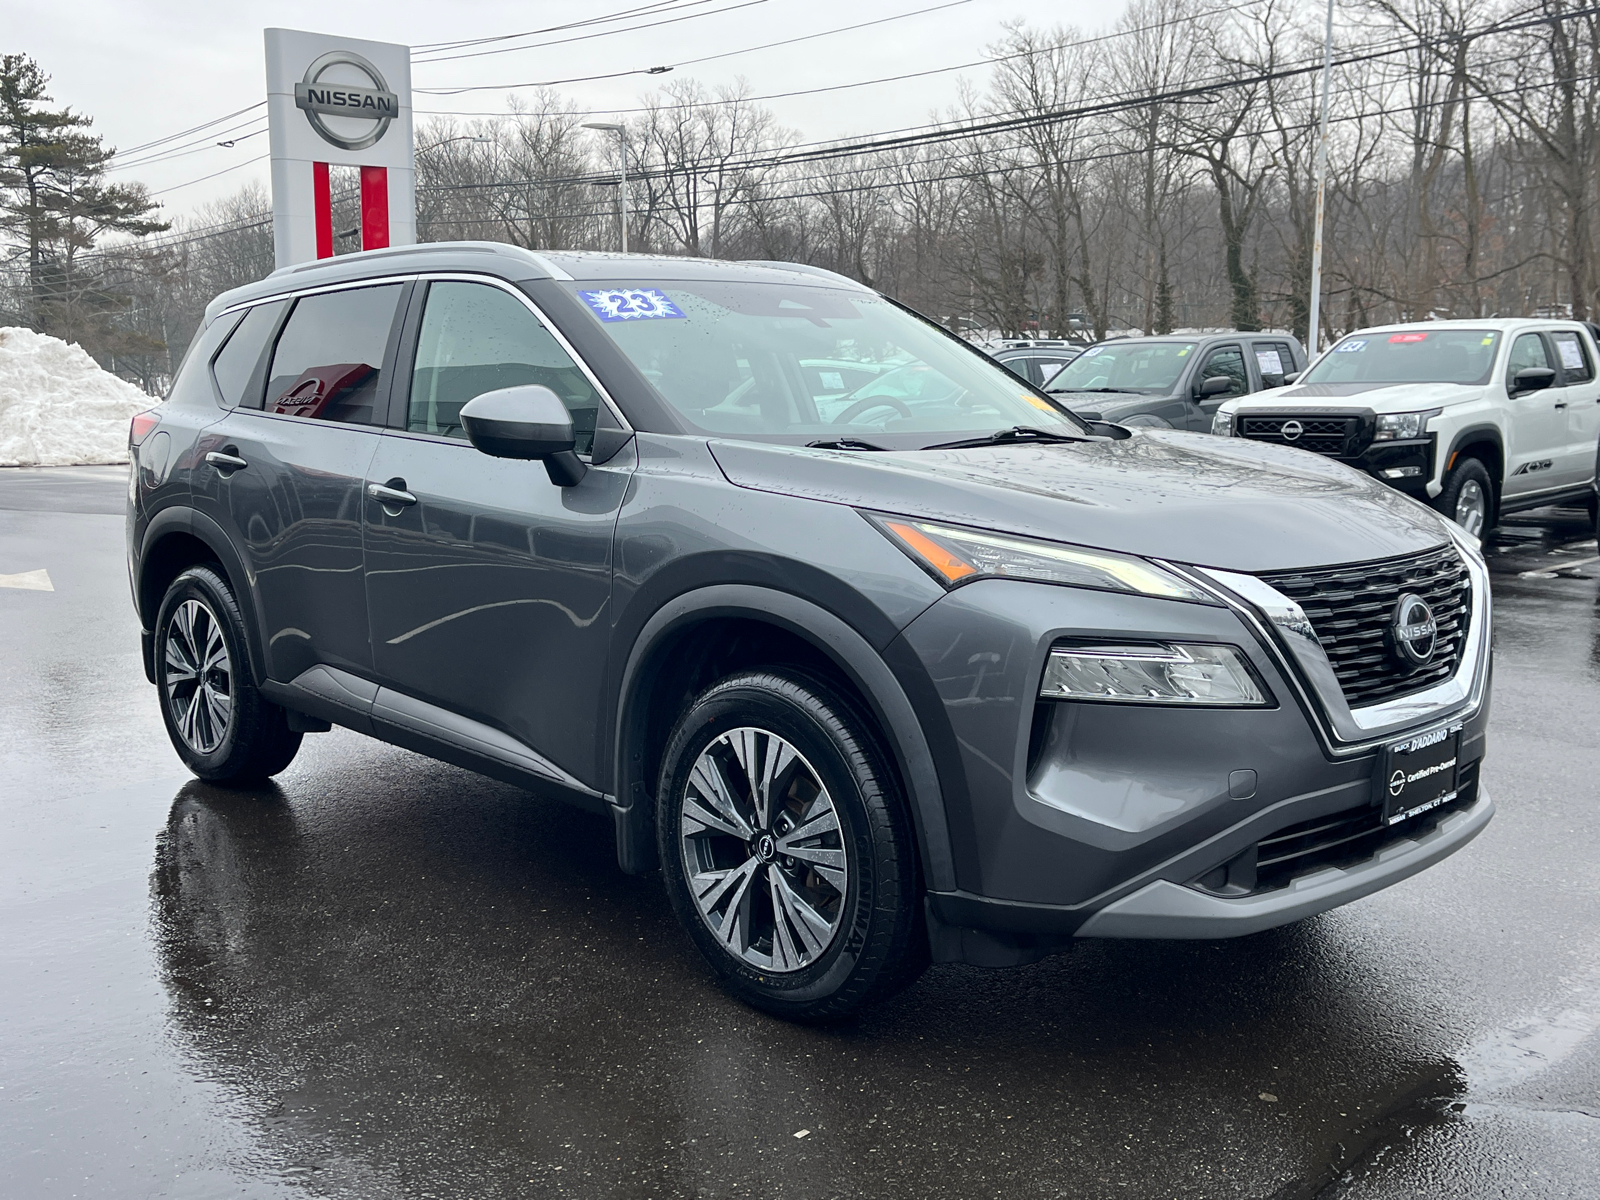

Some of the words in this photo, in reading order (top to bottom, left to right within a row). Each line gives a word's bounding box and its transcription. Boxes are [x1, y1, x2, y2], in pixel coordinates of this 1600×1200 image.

[308, 89, 390, 112] NISSAN
[608, 293, 658, 313] 23
[1399, 622, 1437, 639] NISSAN
[1411, 729, 1448, 752] D'ADDARIO
[1407, 767, 1430, 783] Certified
[1430, 756, 1457, 775] Pre-Owned
